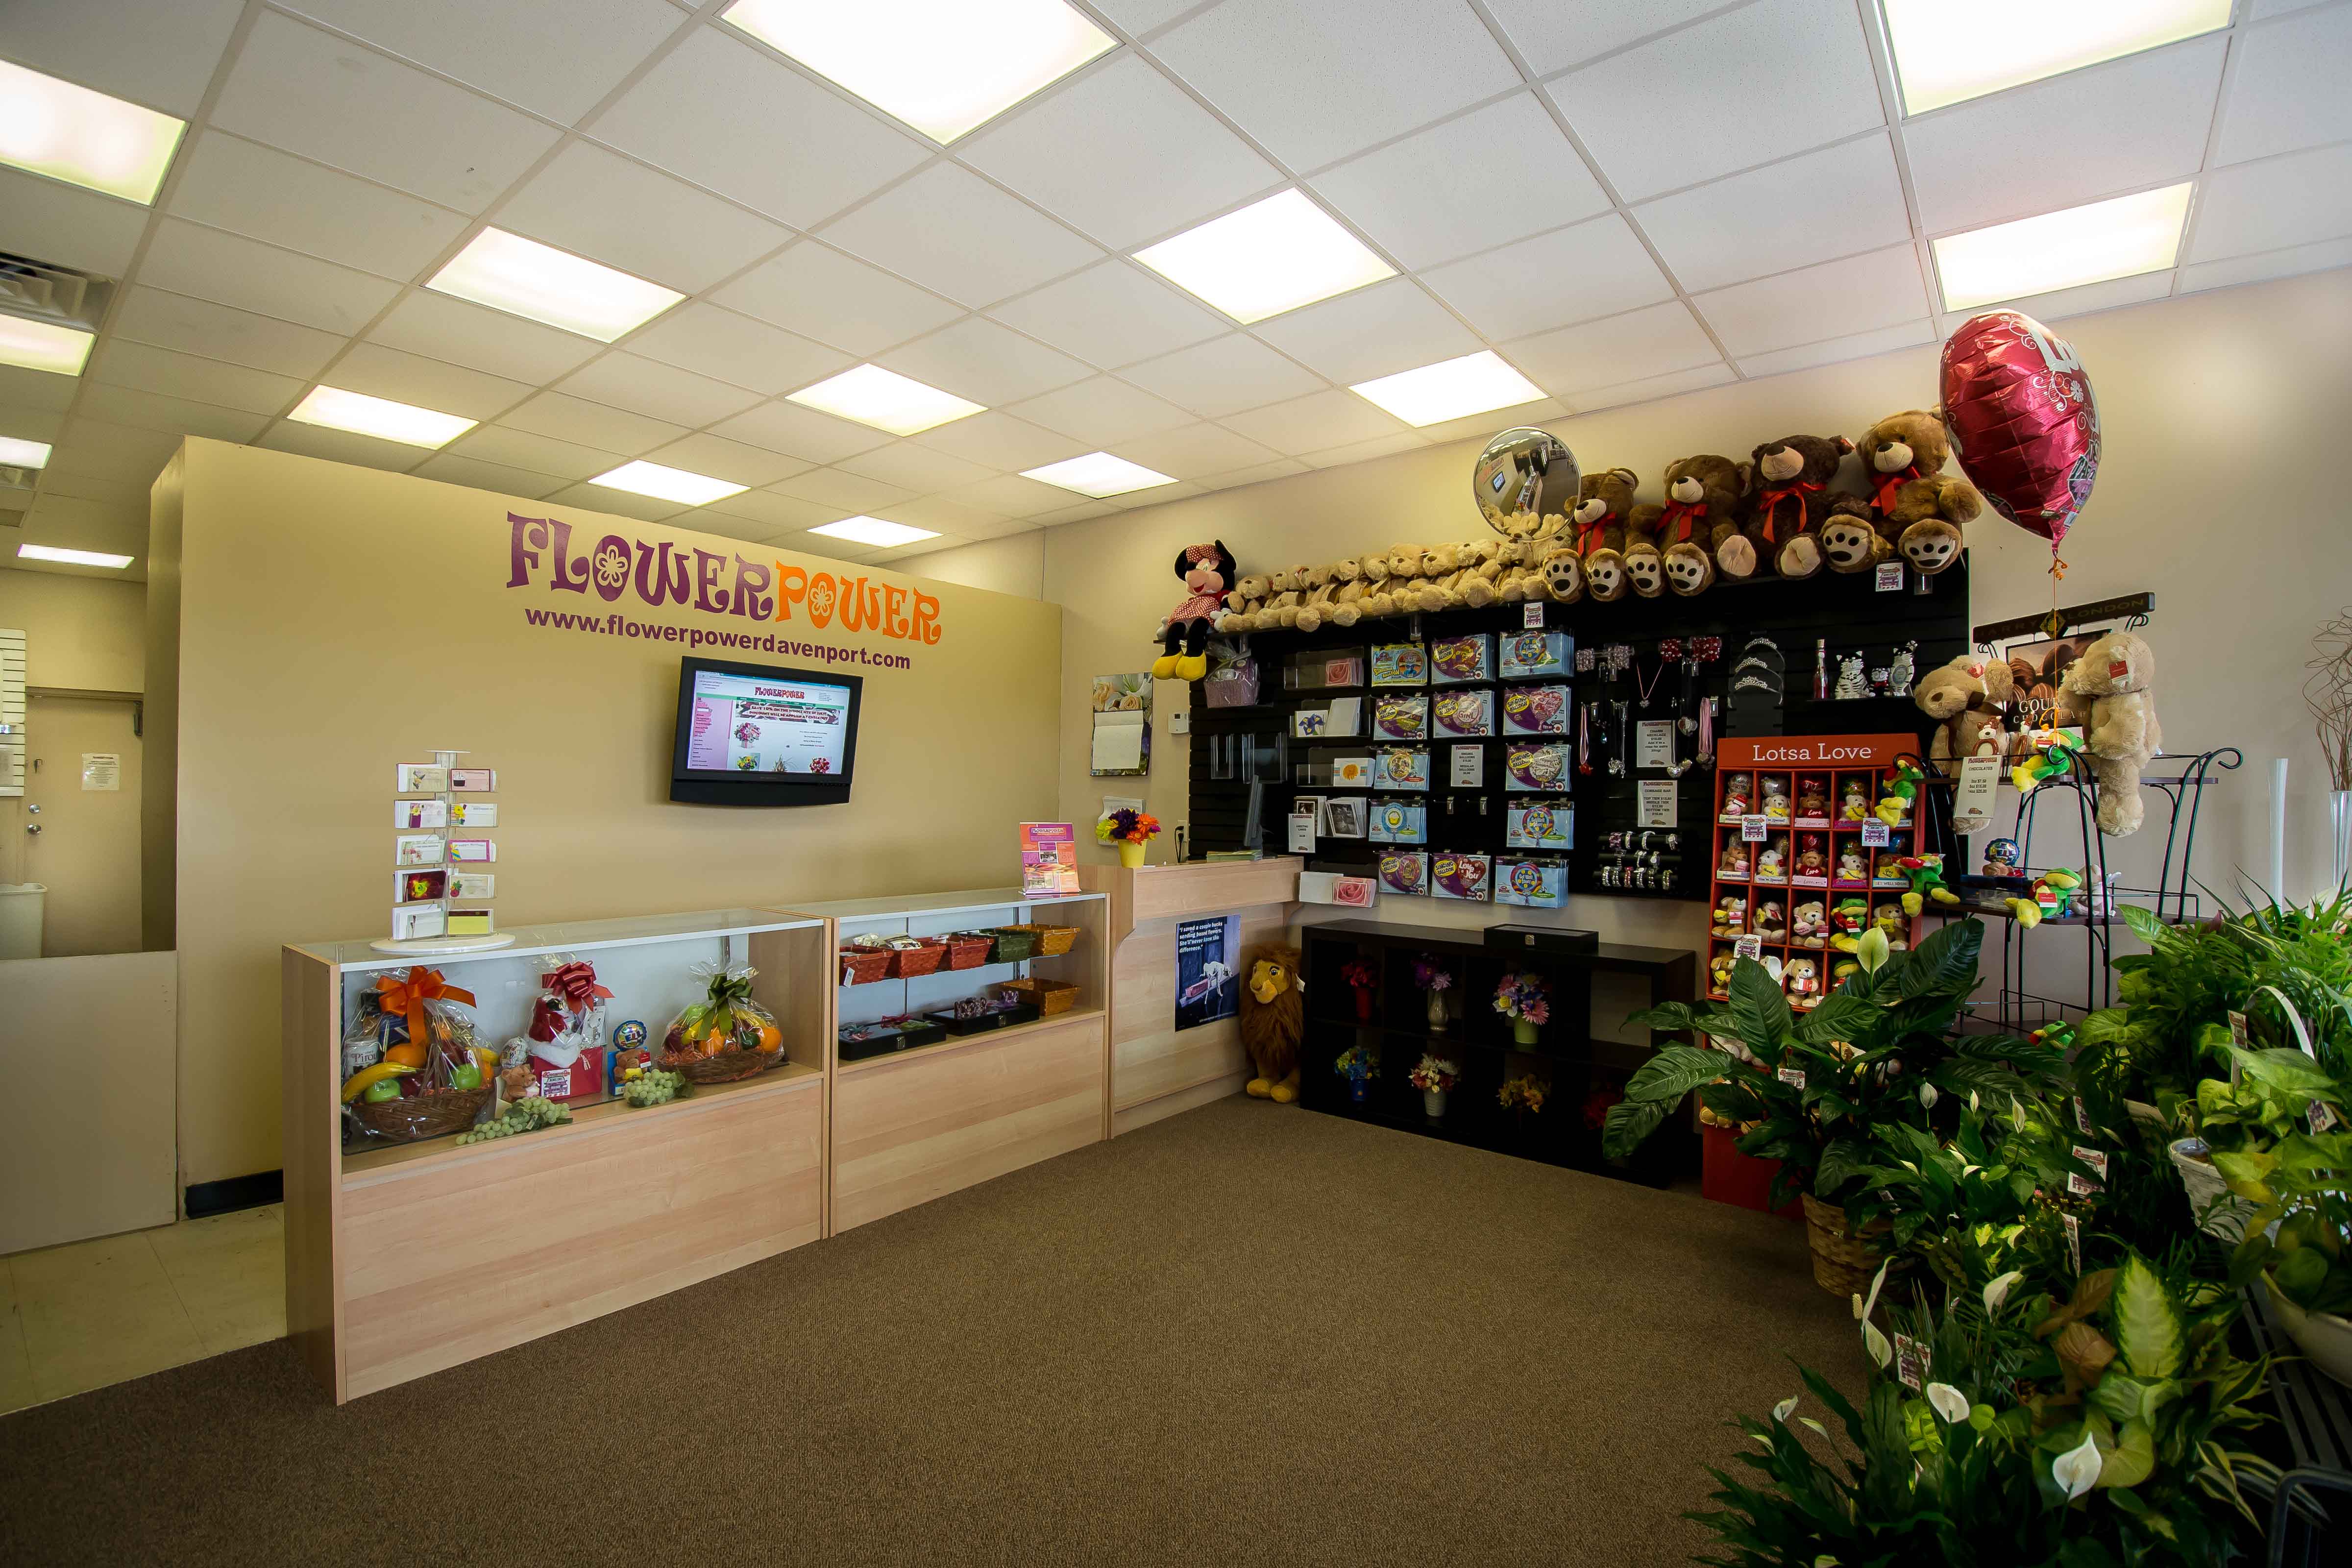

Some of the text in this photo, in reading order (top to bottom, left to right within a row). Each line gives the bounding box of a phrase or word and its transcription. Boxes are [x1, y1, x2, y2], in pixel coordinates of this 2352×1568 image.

[2067, 598, 2145, 620] LONDON
[524, 608, 911, 670] www.flowerpowerdavenport.com
[2019, 698, 2062, 713] GOUR
[1753, 743, 1872, 761] Lotsa Love
[1435, 861, 1454, 870] SINGING
[1438, 866, 1454, 875] BALLOON
[1459, 860, 1474, 872] Love
[1465, 870, 1479, 879] You
